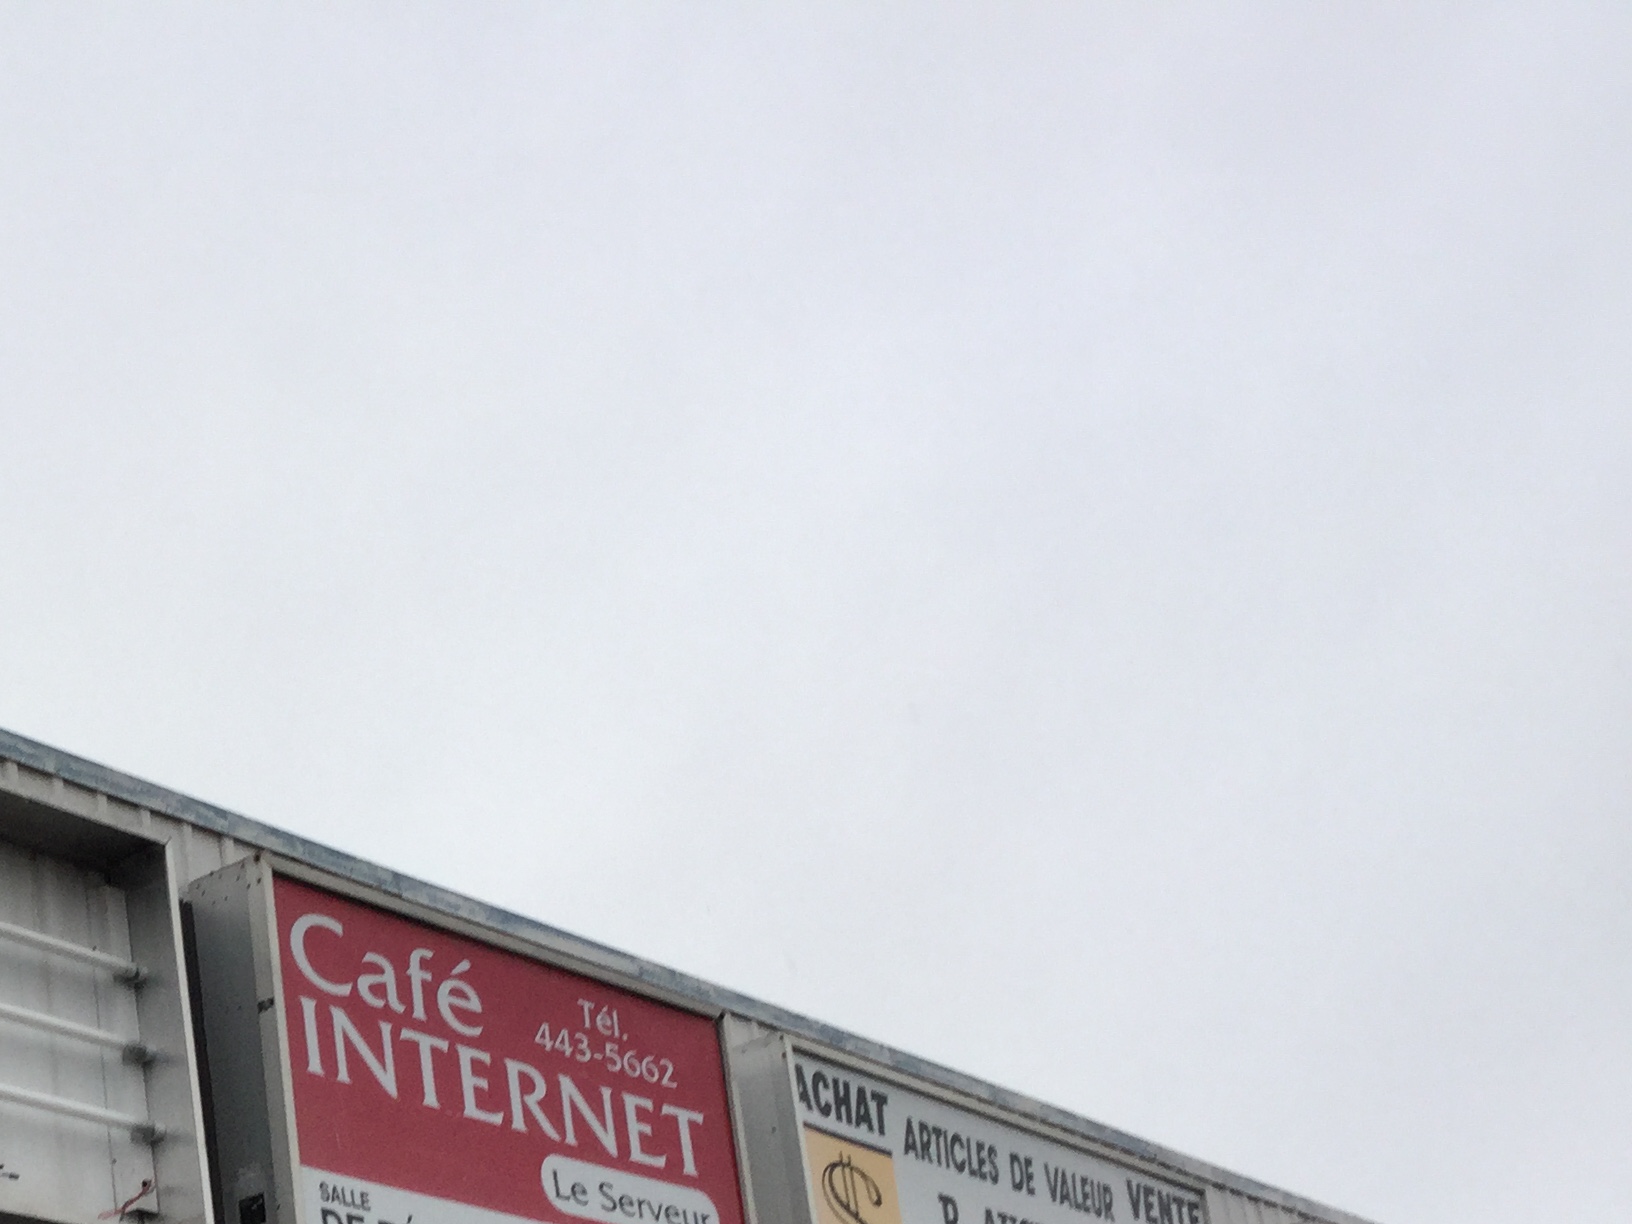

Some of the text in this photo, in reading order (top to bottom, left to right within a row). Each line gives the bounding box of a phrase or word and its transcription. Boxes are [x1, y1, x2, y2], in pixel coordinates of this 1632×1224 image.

[289, 912, 483, 1037] Café
[578, 998, 628, 1040] Tél.
[299, 996, 704, 1178] INTERNET
[534, 1022, 677, 1089] 443-5662
[795, 1063, 888, 1136] ACHAT
[319, 1182, 371, 1211] SALLE
[553, 1169, 588, 1202] Le
[903, 1116, 1116, 1224] ARTICLES DE VALEUR
